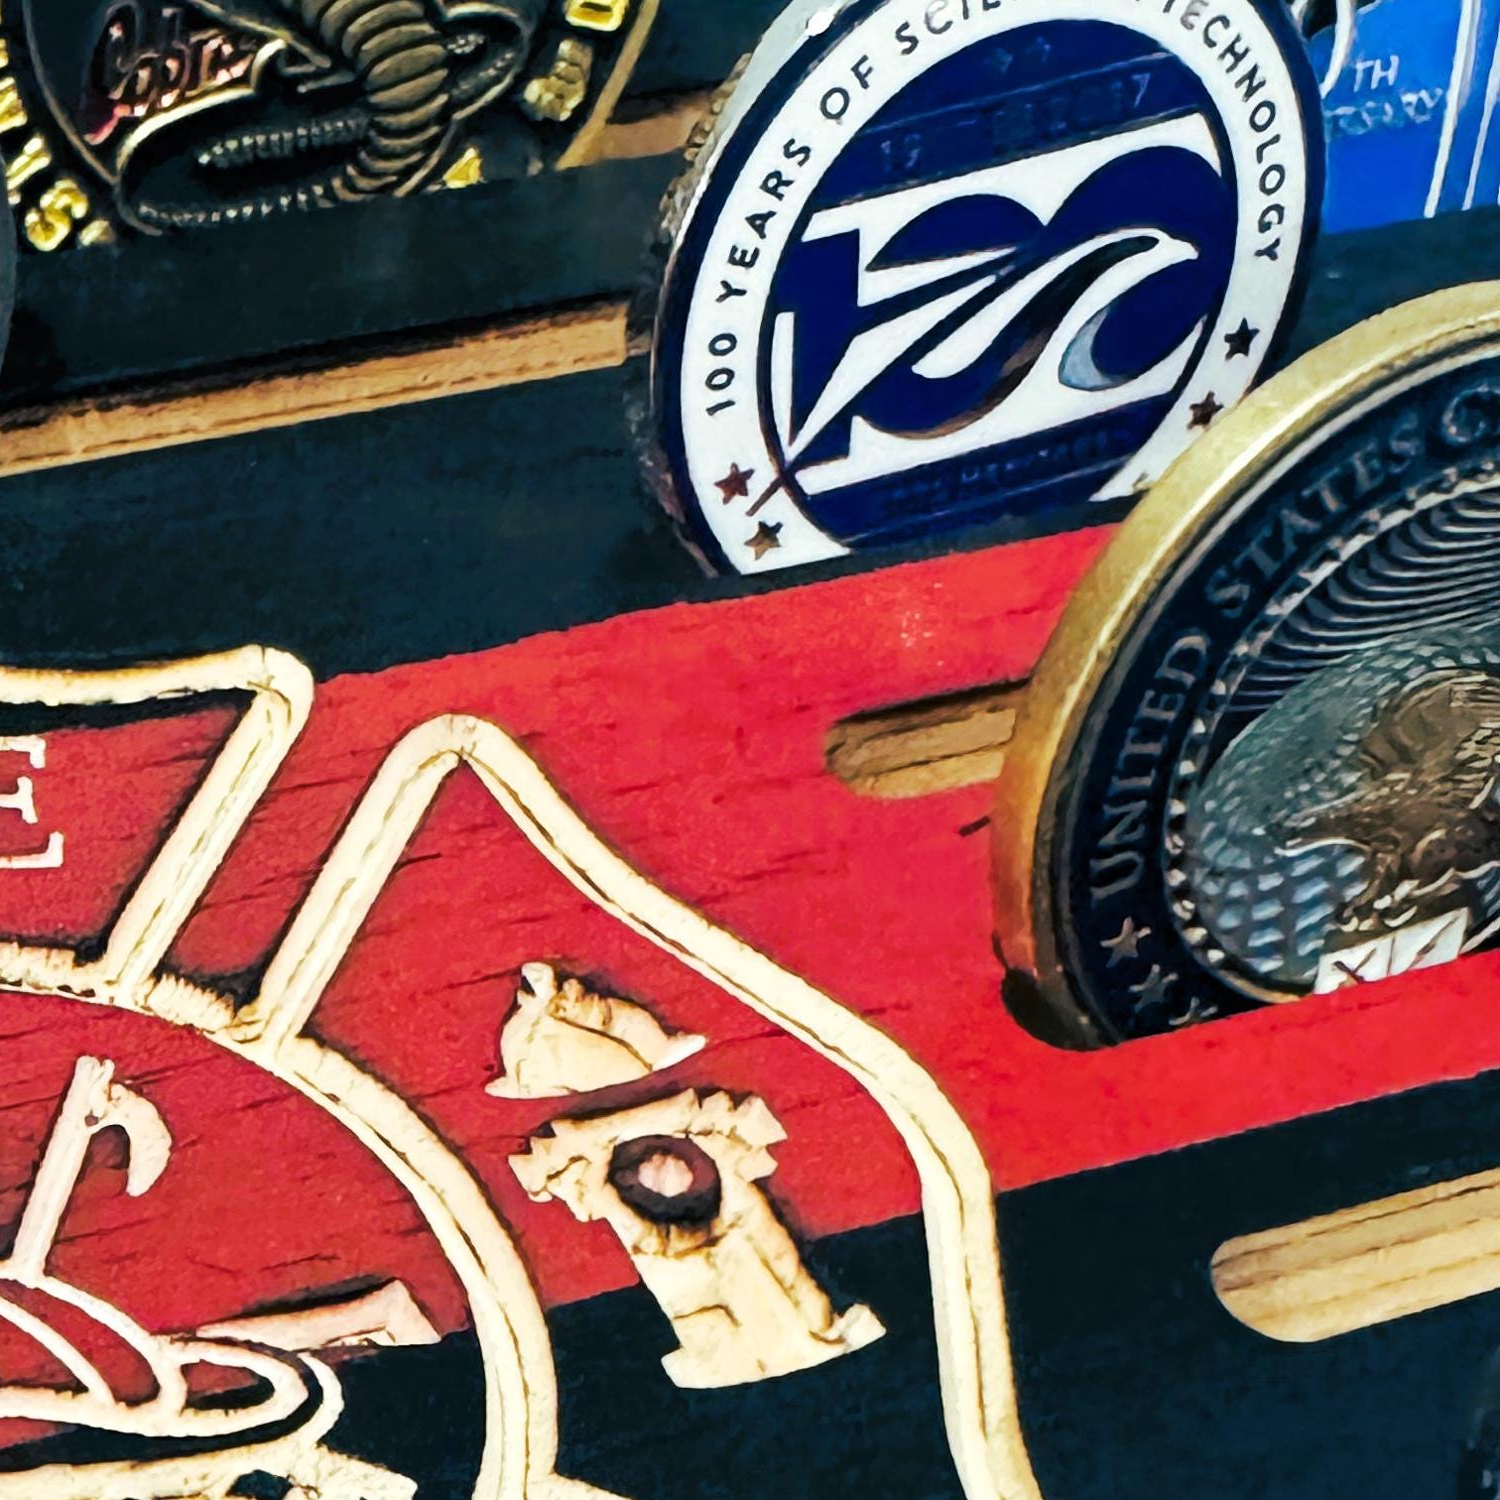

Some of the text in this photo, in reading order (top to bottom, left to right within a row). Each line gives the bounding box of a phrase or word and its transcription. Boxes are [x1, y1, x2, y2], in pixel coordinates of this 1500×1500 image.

[820, 54, 874, 123] OF
[715, 137, 812, 303] YEARS
[705, 331, 738, 416] 100
[1090, 407, 1421, 901] UNITED STATES
